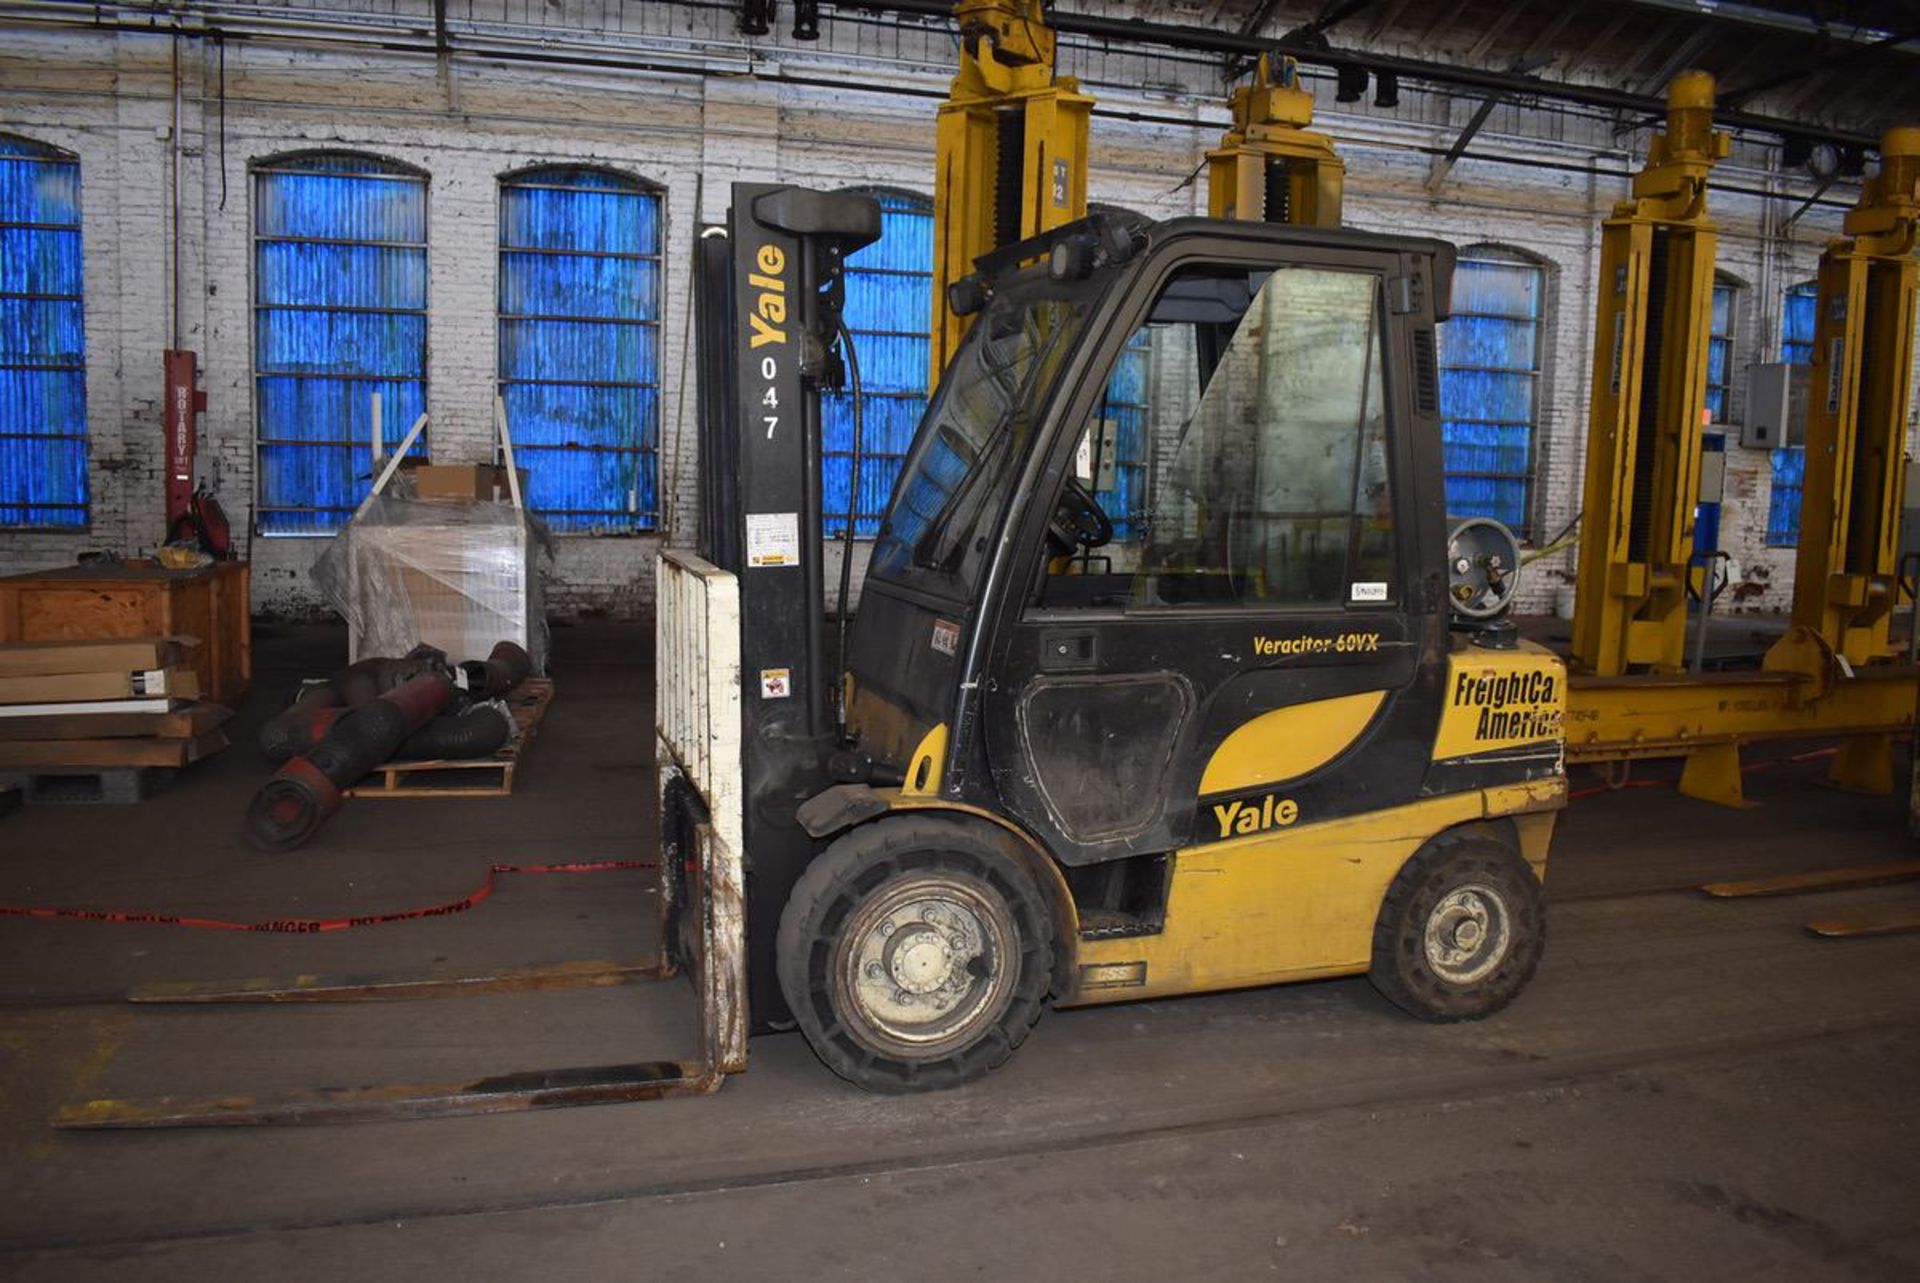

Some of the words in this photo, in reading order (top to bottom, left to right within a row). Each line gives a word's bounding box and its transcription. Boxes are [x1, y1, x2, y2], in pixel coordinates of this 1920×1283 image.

[749, 244, 786, 348] Yale
[177, 386, 187, 456] ROTARY
[1254, 635, 1331, 654] Veracitor
[1336, 633, 1380, 651] 60VX
[1454, 670, 1557, 708] FreightCa
[1214, 794, 1298, 837] Yale
